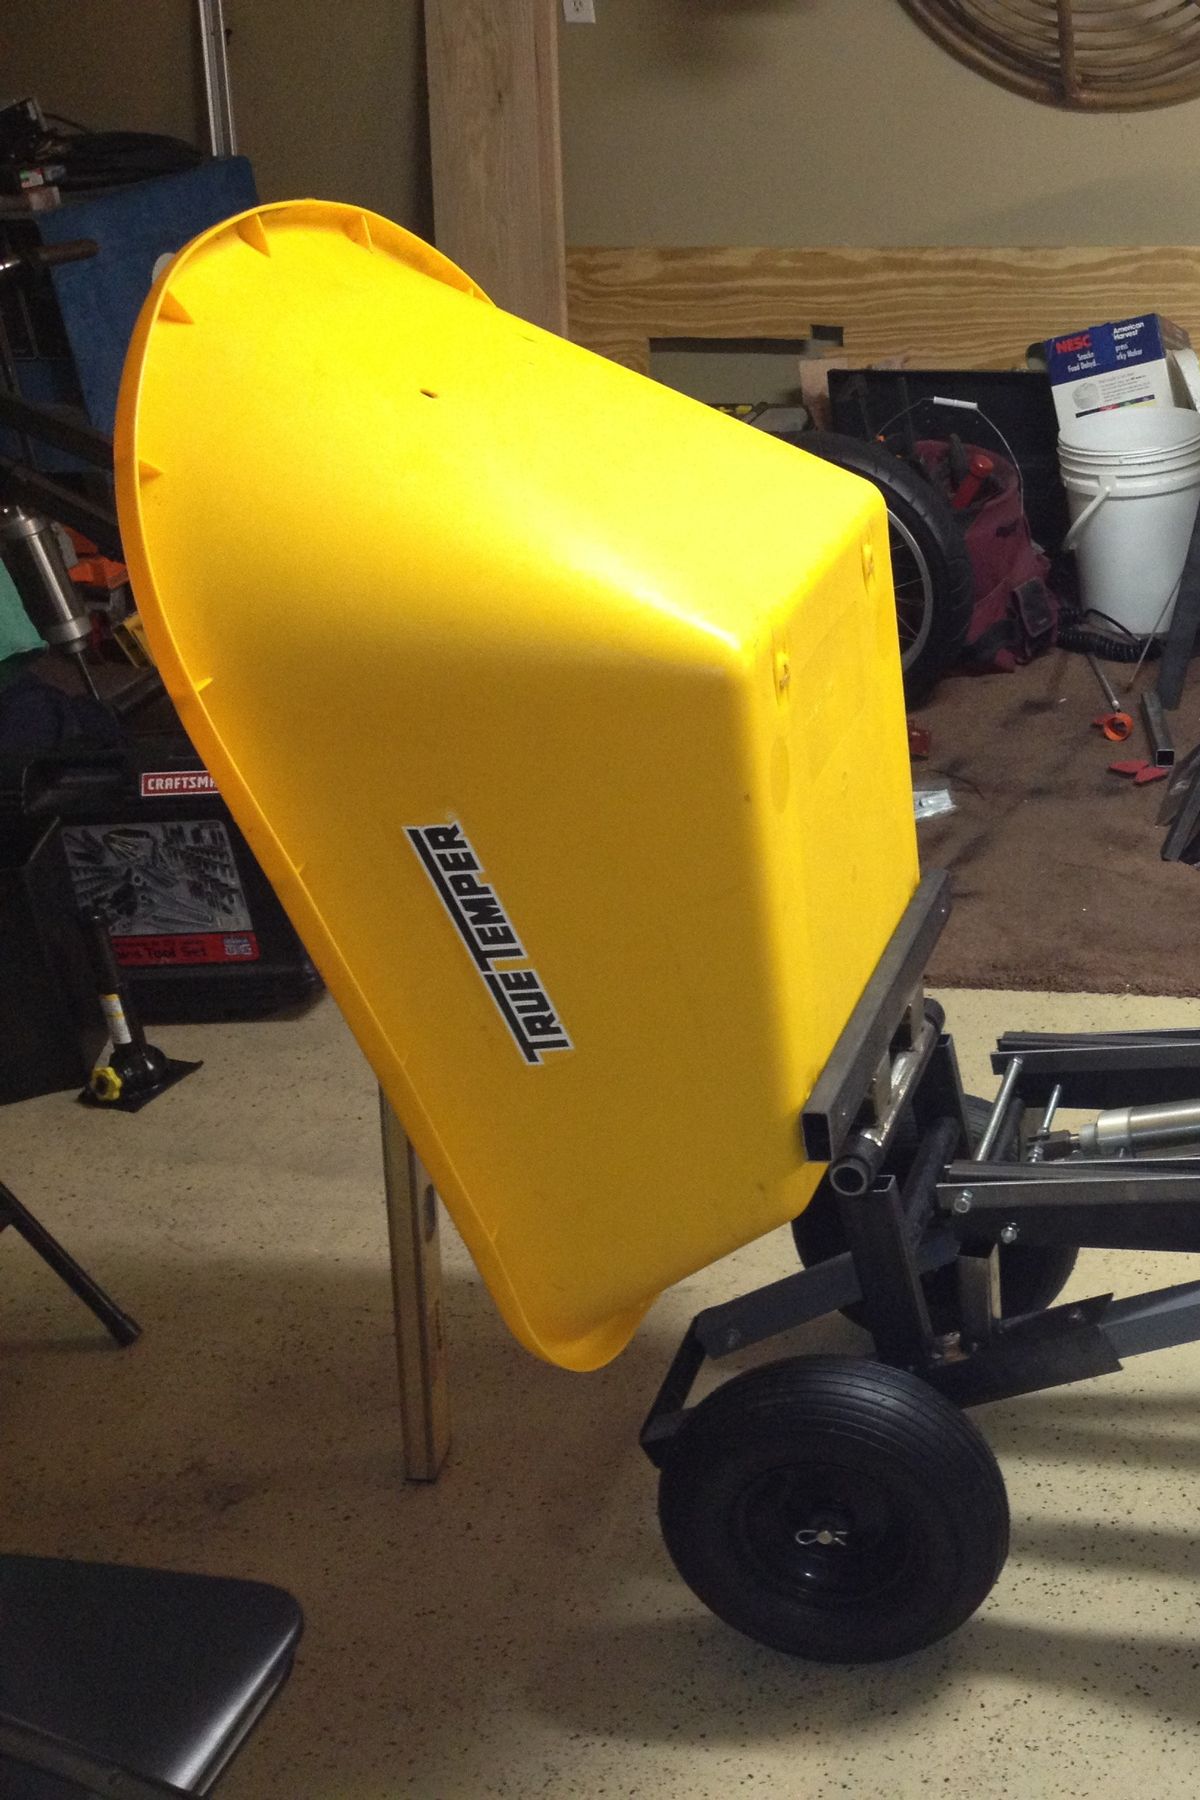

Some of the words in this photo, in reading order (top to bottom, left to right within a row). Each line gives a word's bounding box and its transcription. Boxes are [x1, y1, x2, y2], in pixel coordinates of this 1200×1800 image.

[1113, 322, 1145, 334] American
[1113, 329, 1138, 340] Harvest
[1067, 363, 1080, 373] Food
[405, 822, 525, 972] TEMPER
[484, 970, 571, 1063] TRUE
